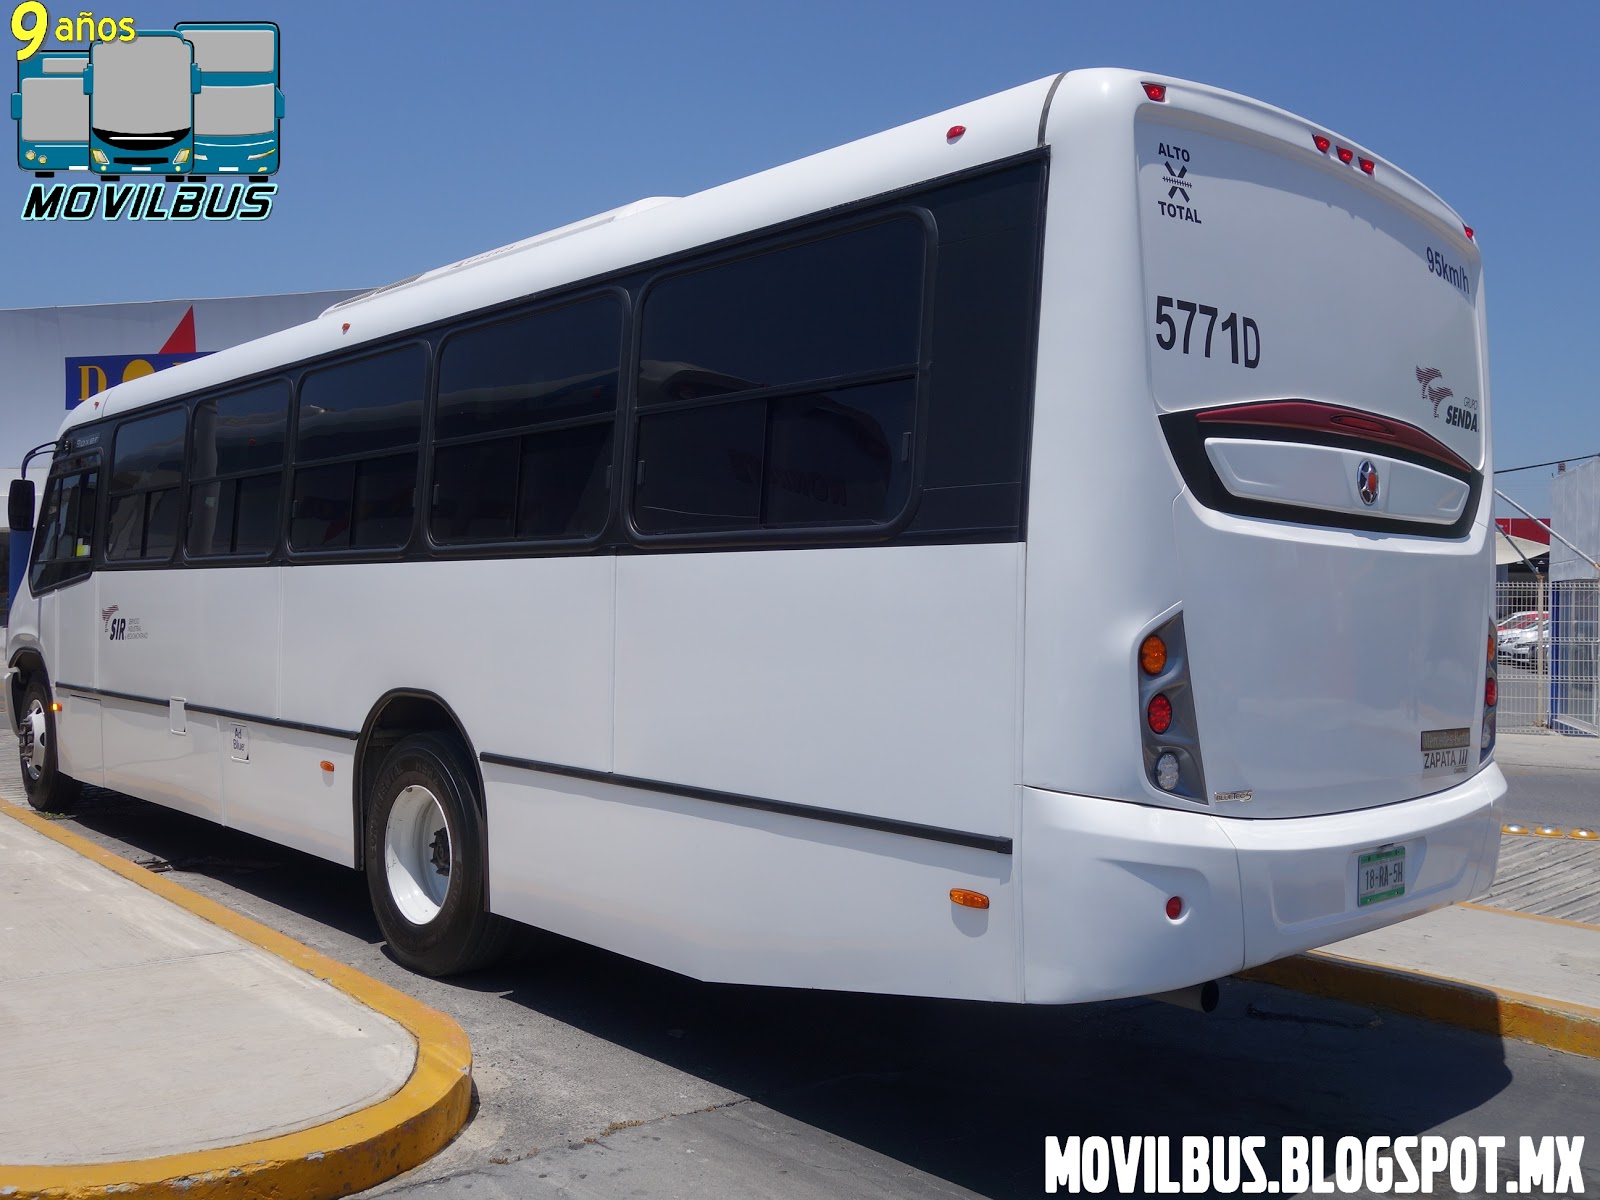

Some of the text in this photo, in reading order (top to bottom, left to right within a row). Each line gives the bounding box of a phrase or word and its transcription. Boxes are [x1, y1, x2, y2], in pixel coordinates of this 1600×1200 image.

[1158, 142, 1190, 163] ALTO
[1158, 200, 1202, 224] TOTAL
[1426, 246, 1470, 294] 95km/h
[1156, 295, 1261, 369] 5771D
[1445, 404, 1478, 433] SENDA
[110, 618, 126, 640] SIR
[233, 739, 245, 751] Blue
[234, 728, 242, 739] Ad
[1423, 750, 1457, 769] ZAPATA
[1365, 861, 1403, 891] 18-RA-5H
